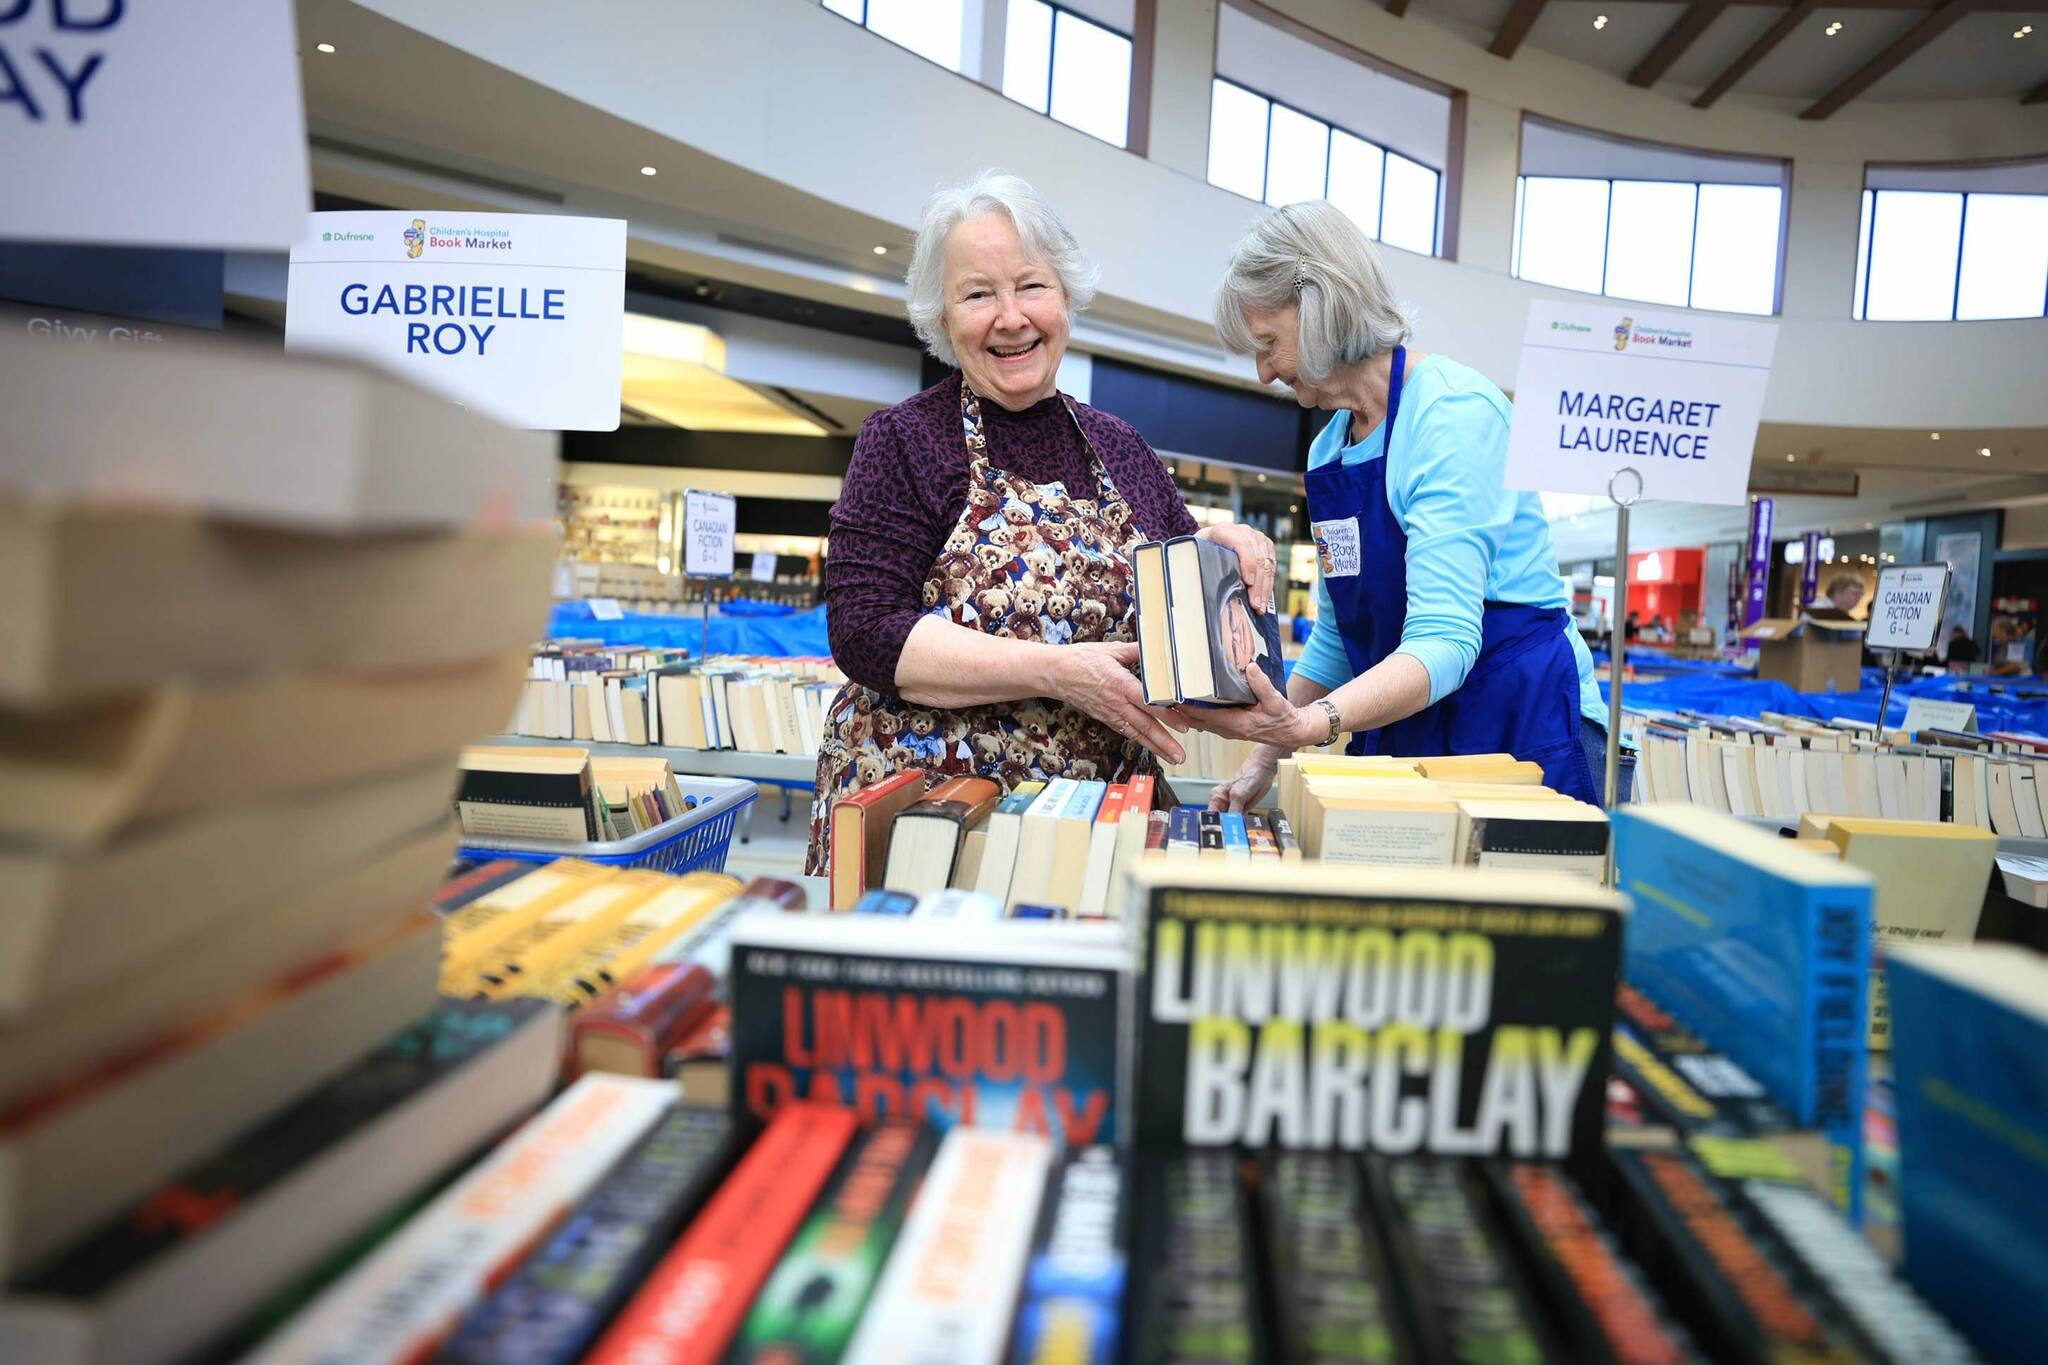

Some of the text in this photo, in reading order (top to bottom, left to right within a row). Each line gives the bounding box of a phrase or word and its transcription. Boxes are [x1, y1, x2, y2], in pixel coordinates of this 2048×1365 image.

[333, 231, 374, 242] Dufresne
[430, 226, 510, 239] Children's Hospital
[430, 236, 512, 250] Book Market
[340, 283, 565, 320] GABRIELLE
[407, 322, 496, 355] ROY
[1633, 333, 1692, 348] Book Market
[1558, 390, 1721, 428] MARGARET
[1559, 424, 1709, 460] LAURENCE
[1330, 542, 1356, 557] Book
[1884, 591, 1932, 605] CANADIAN
[1886, 606, 1921, 620] FICTION
[1150, 917, 1497, 1034] LINWOOD
[782, 986, 1067, 1083] LINWOOD
[1182, 1017, 1599, 1158] BARCLAY
